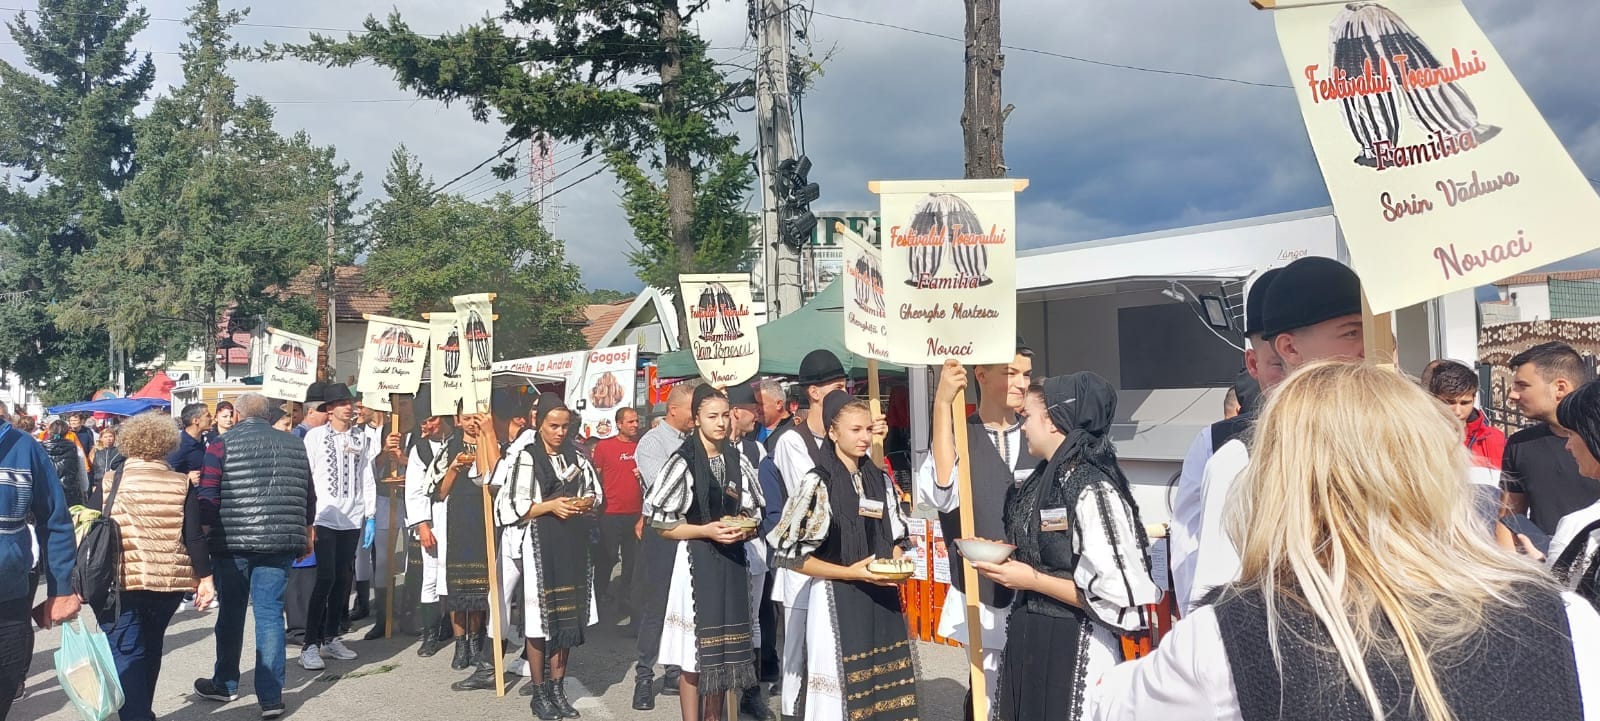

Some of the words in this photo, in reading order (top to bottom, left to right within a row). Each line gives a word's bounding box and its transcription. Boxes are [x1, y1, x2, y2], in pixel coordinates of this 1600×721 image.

[1304, 57, 1392, 103] Festivalul
[1393, 48, 1486, 93] Tocanului
[1373, 130, 1478, 171] Familia
[1380, 191, 1433, 222] Sorin
[890, 224, 946, 248] Festivalul
[951, 224, 1007, 248] Tocanului
[1433, 230, 1533, 280] Novaci
[917, 271, 980, 290] Familia
[899, 302, 946, 323] Gheorghe
[951, 302, 1000, 320] Martescu
[867, 341, 889, 358] Nova
[926, 337, 974, 357] Novaci
[547, 357, 573, 370] Andrei
[711, 370, 738, 382] Novaci
